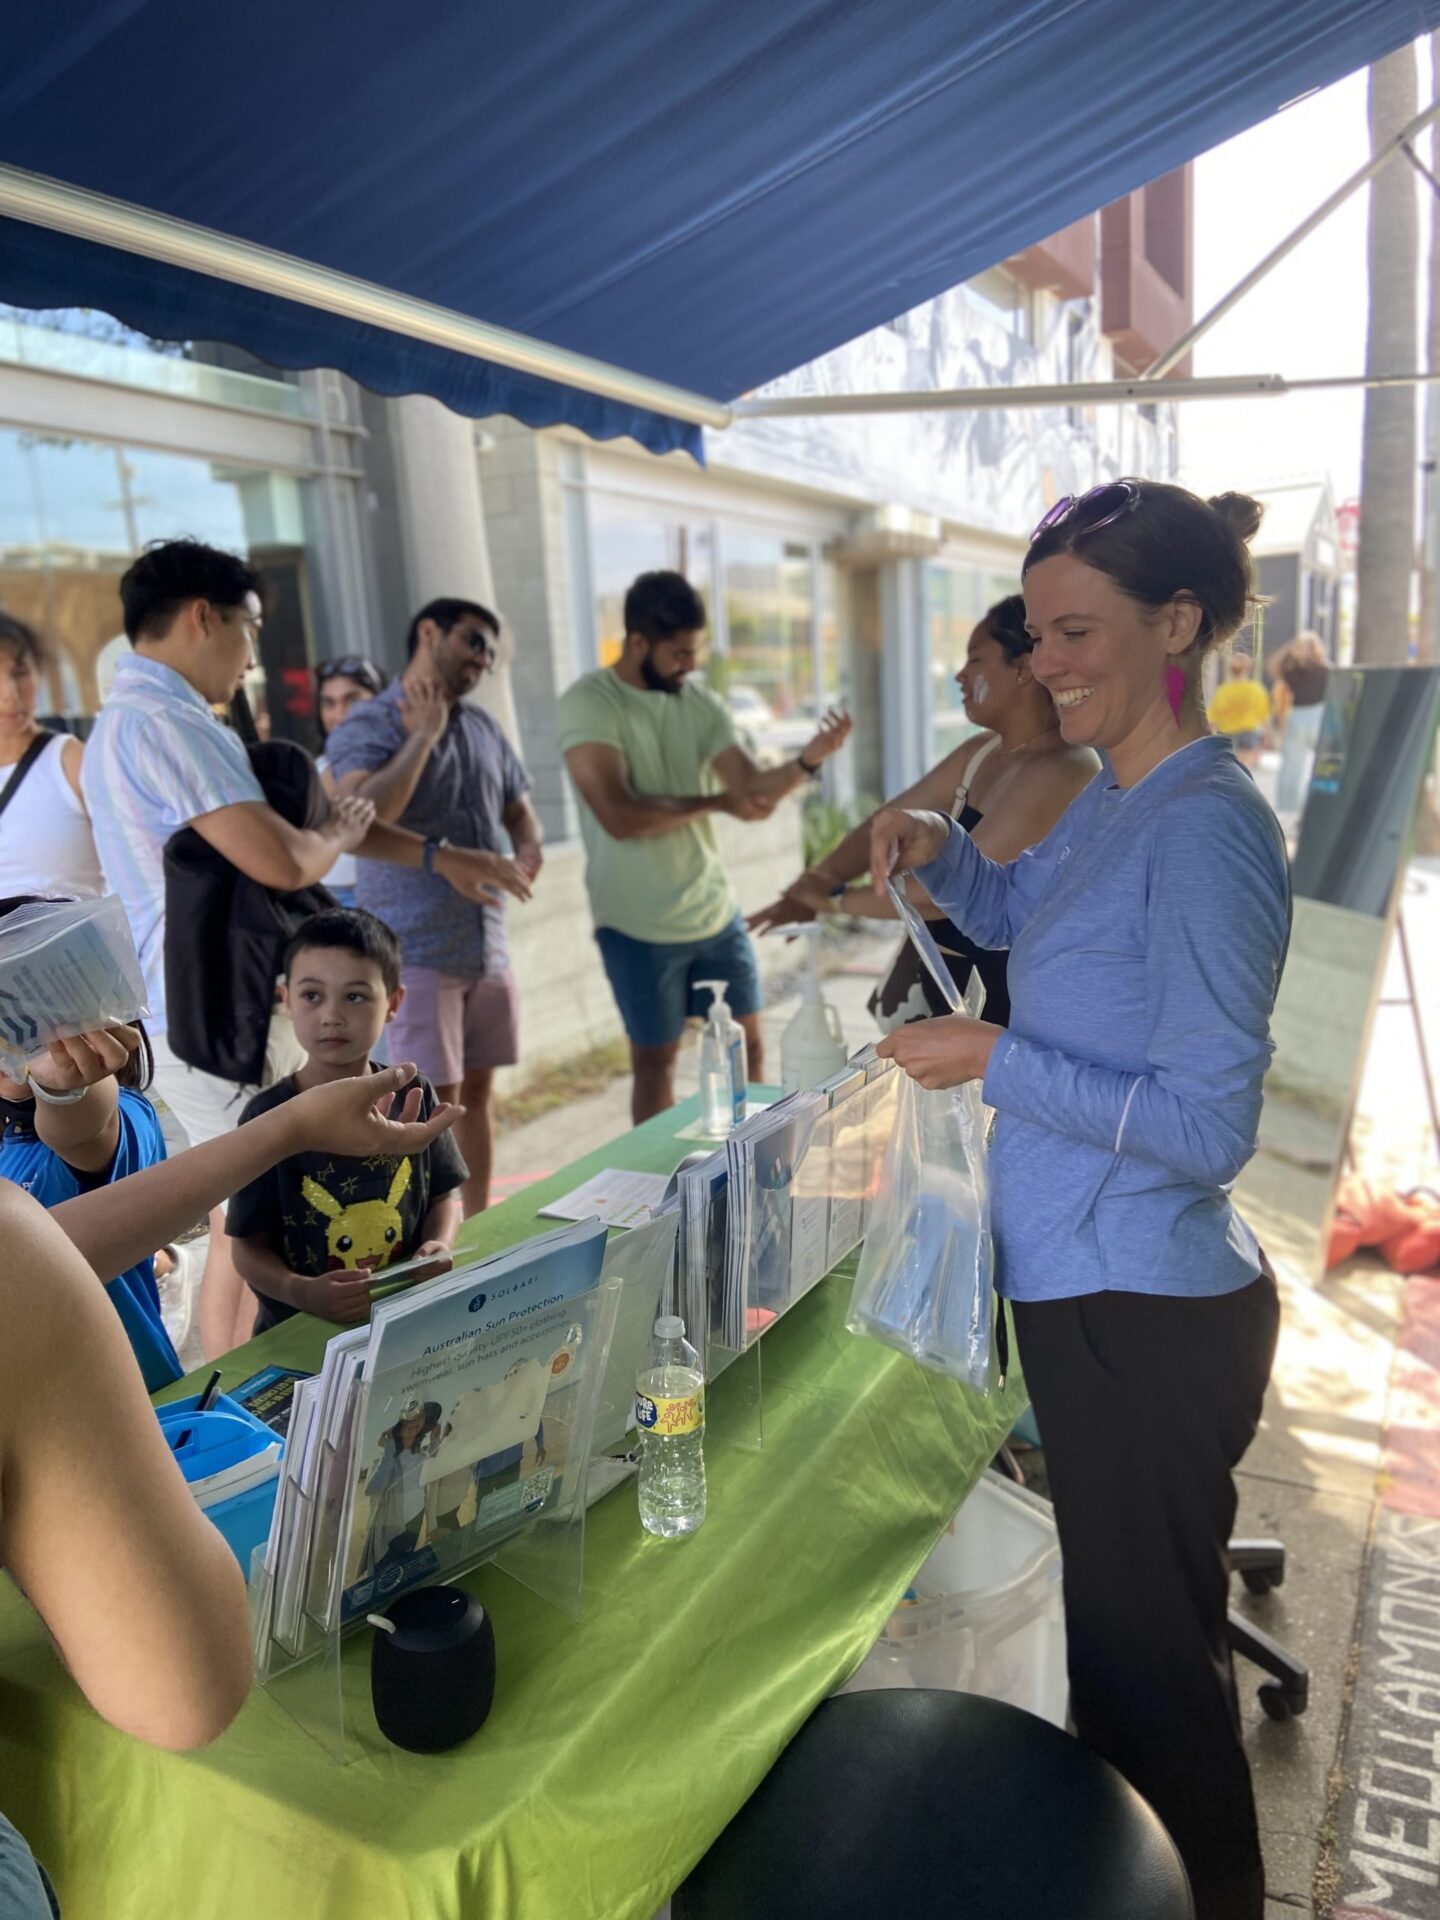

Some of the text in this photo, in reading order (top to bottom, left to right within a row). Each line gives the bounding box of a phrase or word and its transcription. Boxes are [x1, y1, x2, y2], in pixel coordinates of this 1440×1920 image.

[490, 1275, 538, 1301] SOLBARI
[422, 1294, 564, 1356] Australian Sun Protection
